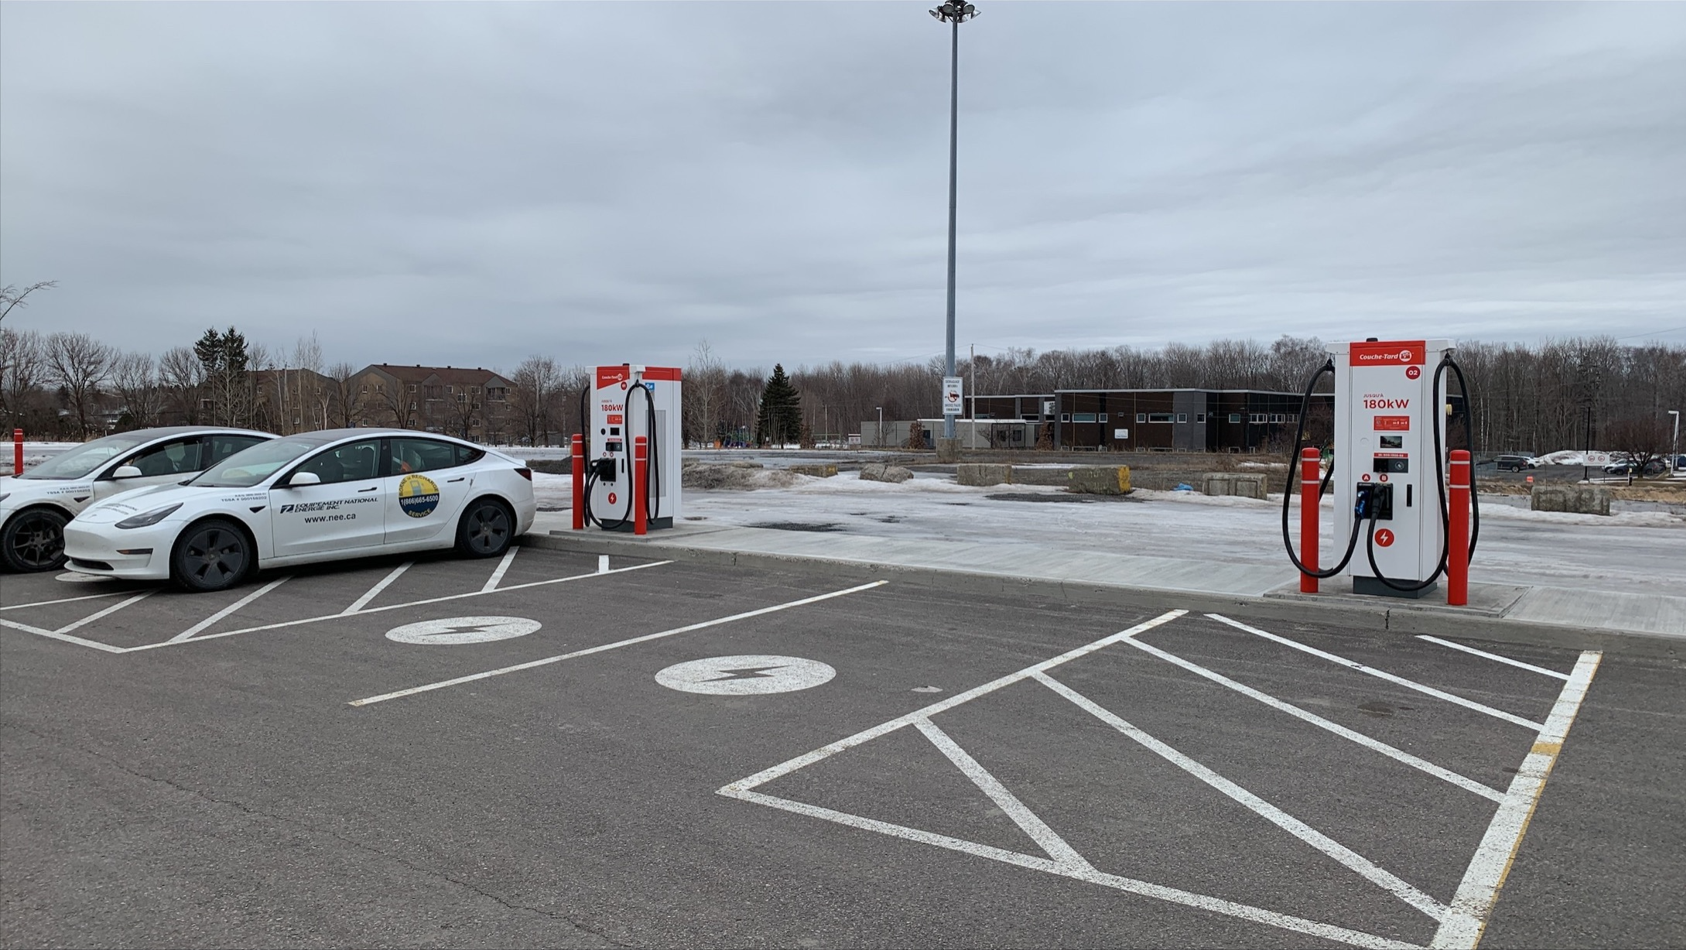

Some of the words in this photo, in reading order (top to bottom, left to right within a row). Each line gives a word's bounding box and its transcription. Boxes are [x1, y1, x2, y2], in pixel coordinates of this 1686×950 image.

[1363, 399, 1409, 409] 180kW
[344, 497, 378, 505] NATIONAL
[408, 508, 431, 517] SERVICE
[304, 513, 356, 523] www.nee.ca
